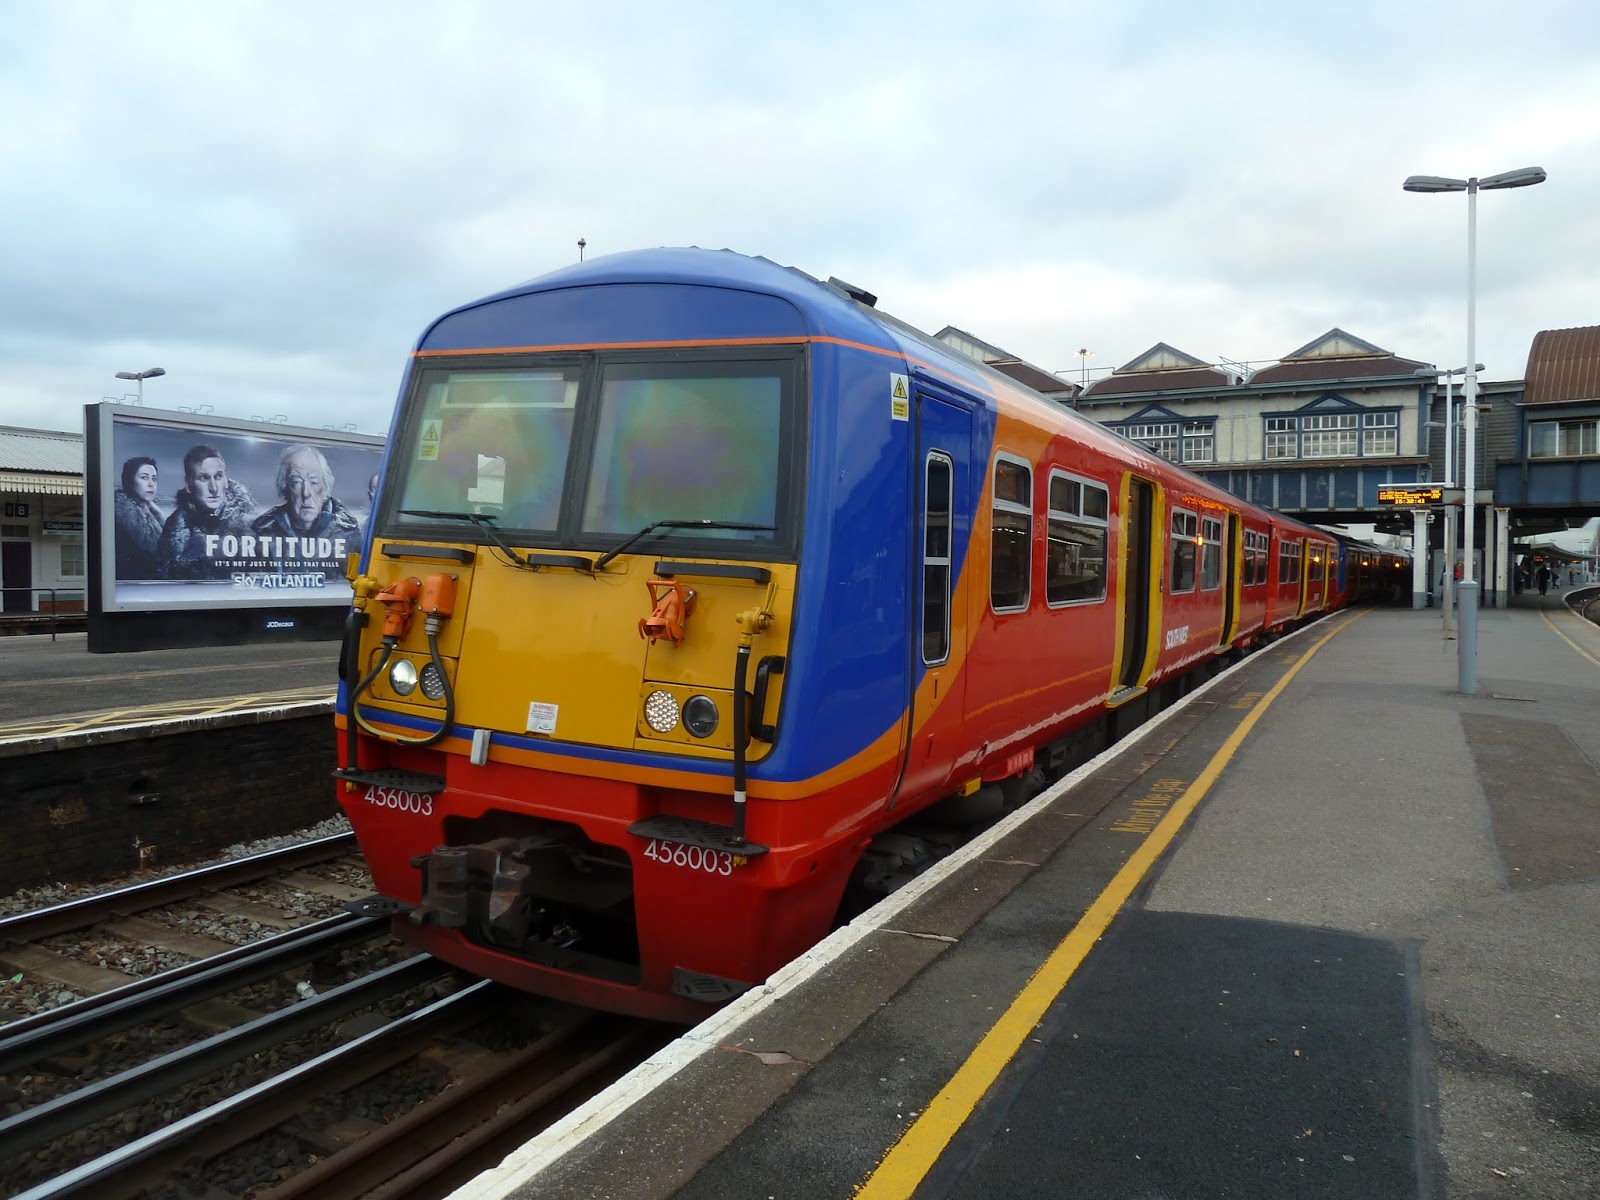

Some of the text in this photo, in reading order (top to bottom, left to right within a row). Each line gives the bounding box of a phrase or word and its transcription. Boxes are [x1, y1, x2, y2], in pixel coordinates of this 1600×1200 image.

[18, 505, 25, 515] 8
[205, 534, 346, 558] FORTITUDE
[234, 573, 324, 588] sky ATLANTIC
[364, 784, 433, 816] 456003
[643, 838, 733, 876] 456003
